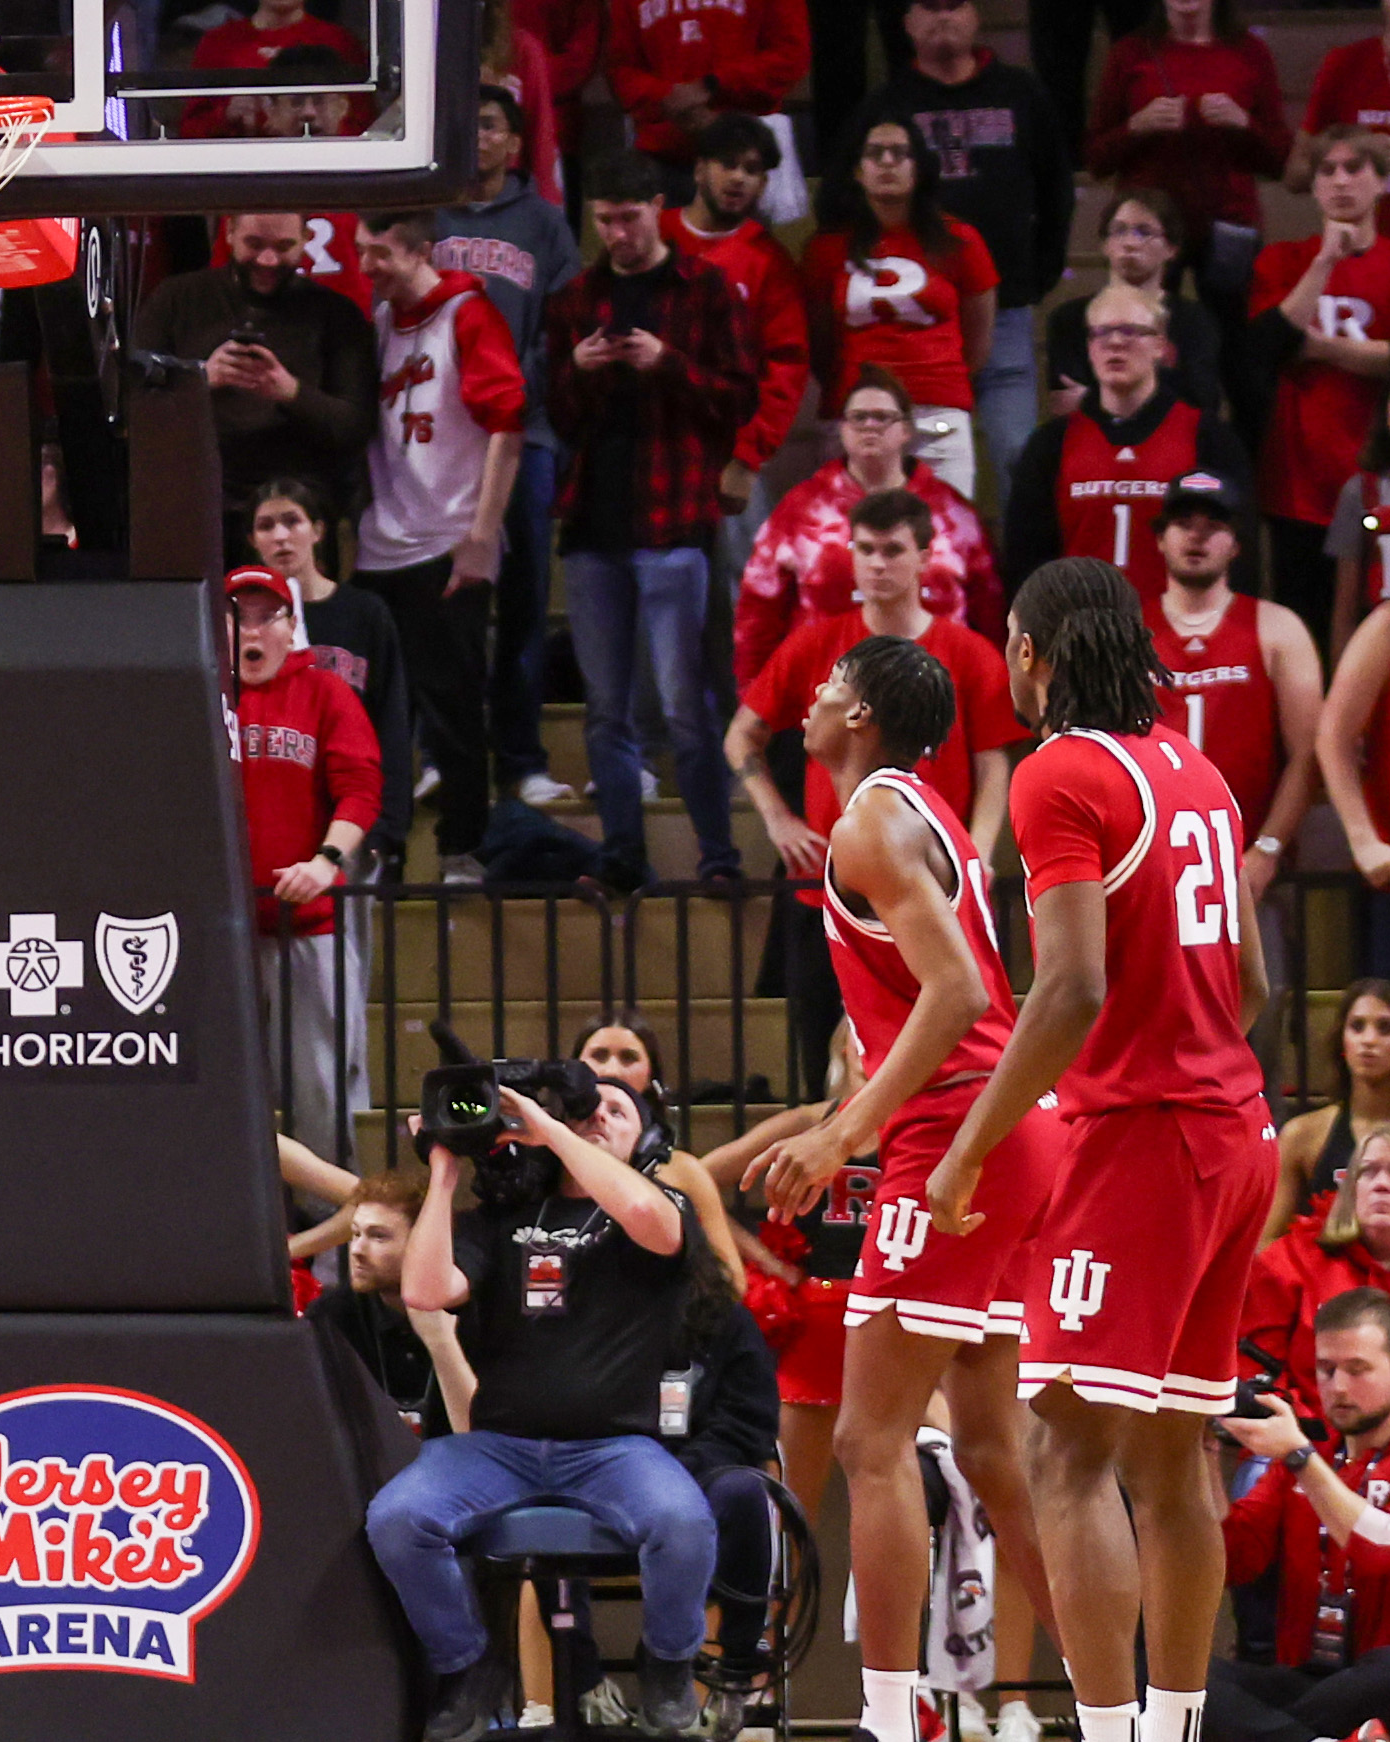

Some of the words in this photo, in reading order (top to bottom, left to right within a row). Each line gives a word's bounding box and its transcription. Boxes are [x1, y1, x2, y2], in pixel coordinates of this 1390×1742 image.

[845, 255, 937, 329] R
[1317, 294, 1376, 343] R
[1112, 503, 1132, 568] 1
[1147, 664, 1251, 689] TGERS
[1168, 808, 1242, 947] 21
